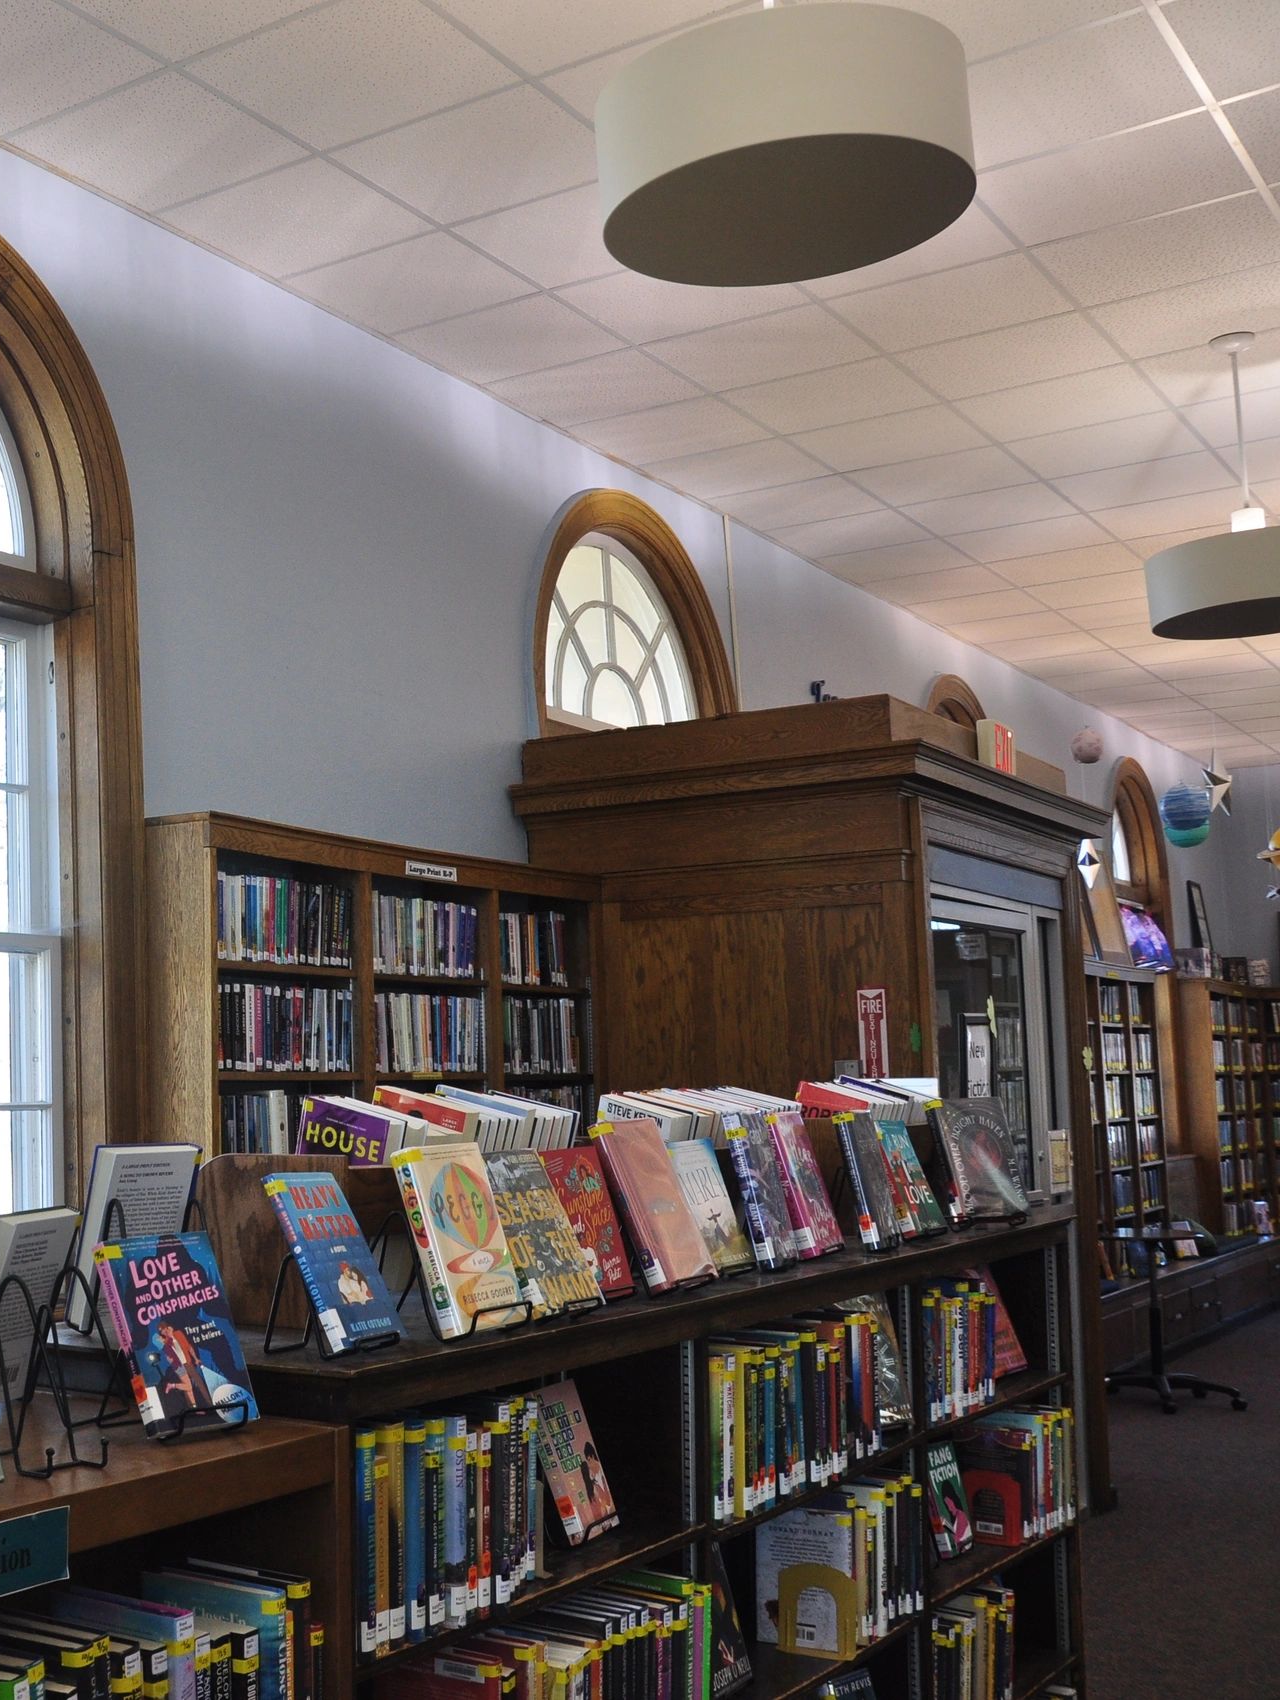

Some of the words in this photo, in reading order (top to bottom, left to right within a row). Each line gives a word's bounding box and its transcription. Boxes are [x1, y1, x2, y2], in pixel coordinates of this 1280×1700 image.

[410, 865, 426, 875] Large
[426, 868, 441, 876] Print
[861, 999, 882, 1014] FIRE
[970, 1042, 985, 1058] New
[607, 1103, 632, 1118] STEVE
[305, 1121, 381, 1163] HOUSE
[950, 1143, 964, 1172] OVER
[979, 1115, 1006, 1138] HAVEN
[289, 1185, 340, 1210] HEAVY
[904, 1185, 933, 1204] LOVE
[508, 1235, 536, 1268] OF
[129, 1252, 180, 1289] LOVE
[298, 1256, 310, 1283] KATIE
[105, 1280, 114, 1300] OTHER
[135, 1293, 152, 1305] AND
[151, 1270, 202, 1300] OTHER
[463, 1289, 490, 1304] REBECCA
[491, 1285, 515, 1298] GODFREY
[137, 1285, 220, 1326] CONSPIRACIES
[185, 1325, 199, 1336] They
[201, 1320, 216, 1329] want
[350, 1320, 369, 1332] KATIE
[193, 1335, 201, 1343] to
[928, 1446, 952, 1467] FANG
[929, 1462, 959, 1483] FICTION
[713, 1671, 733, 1691] JOSEPH
[851, 1677, 871, 1692] REVIS
